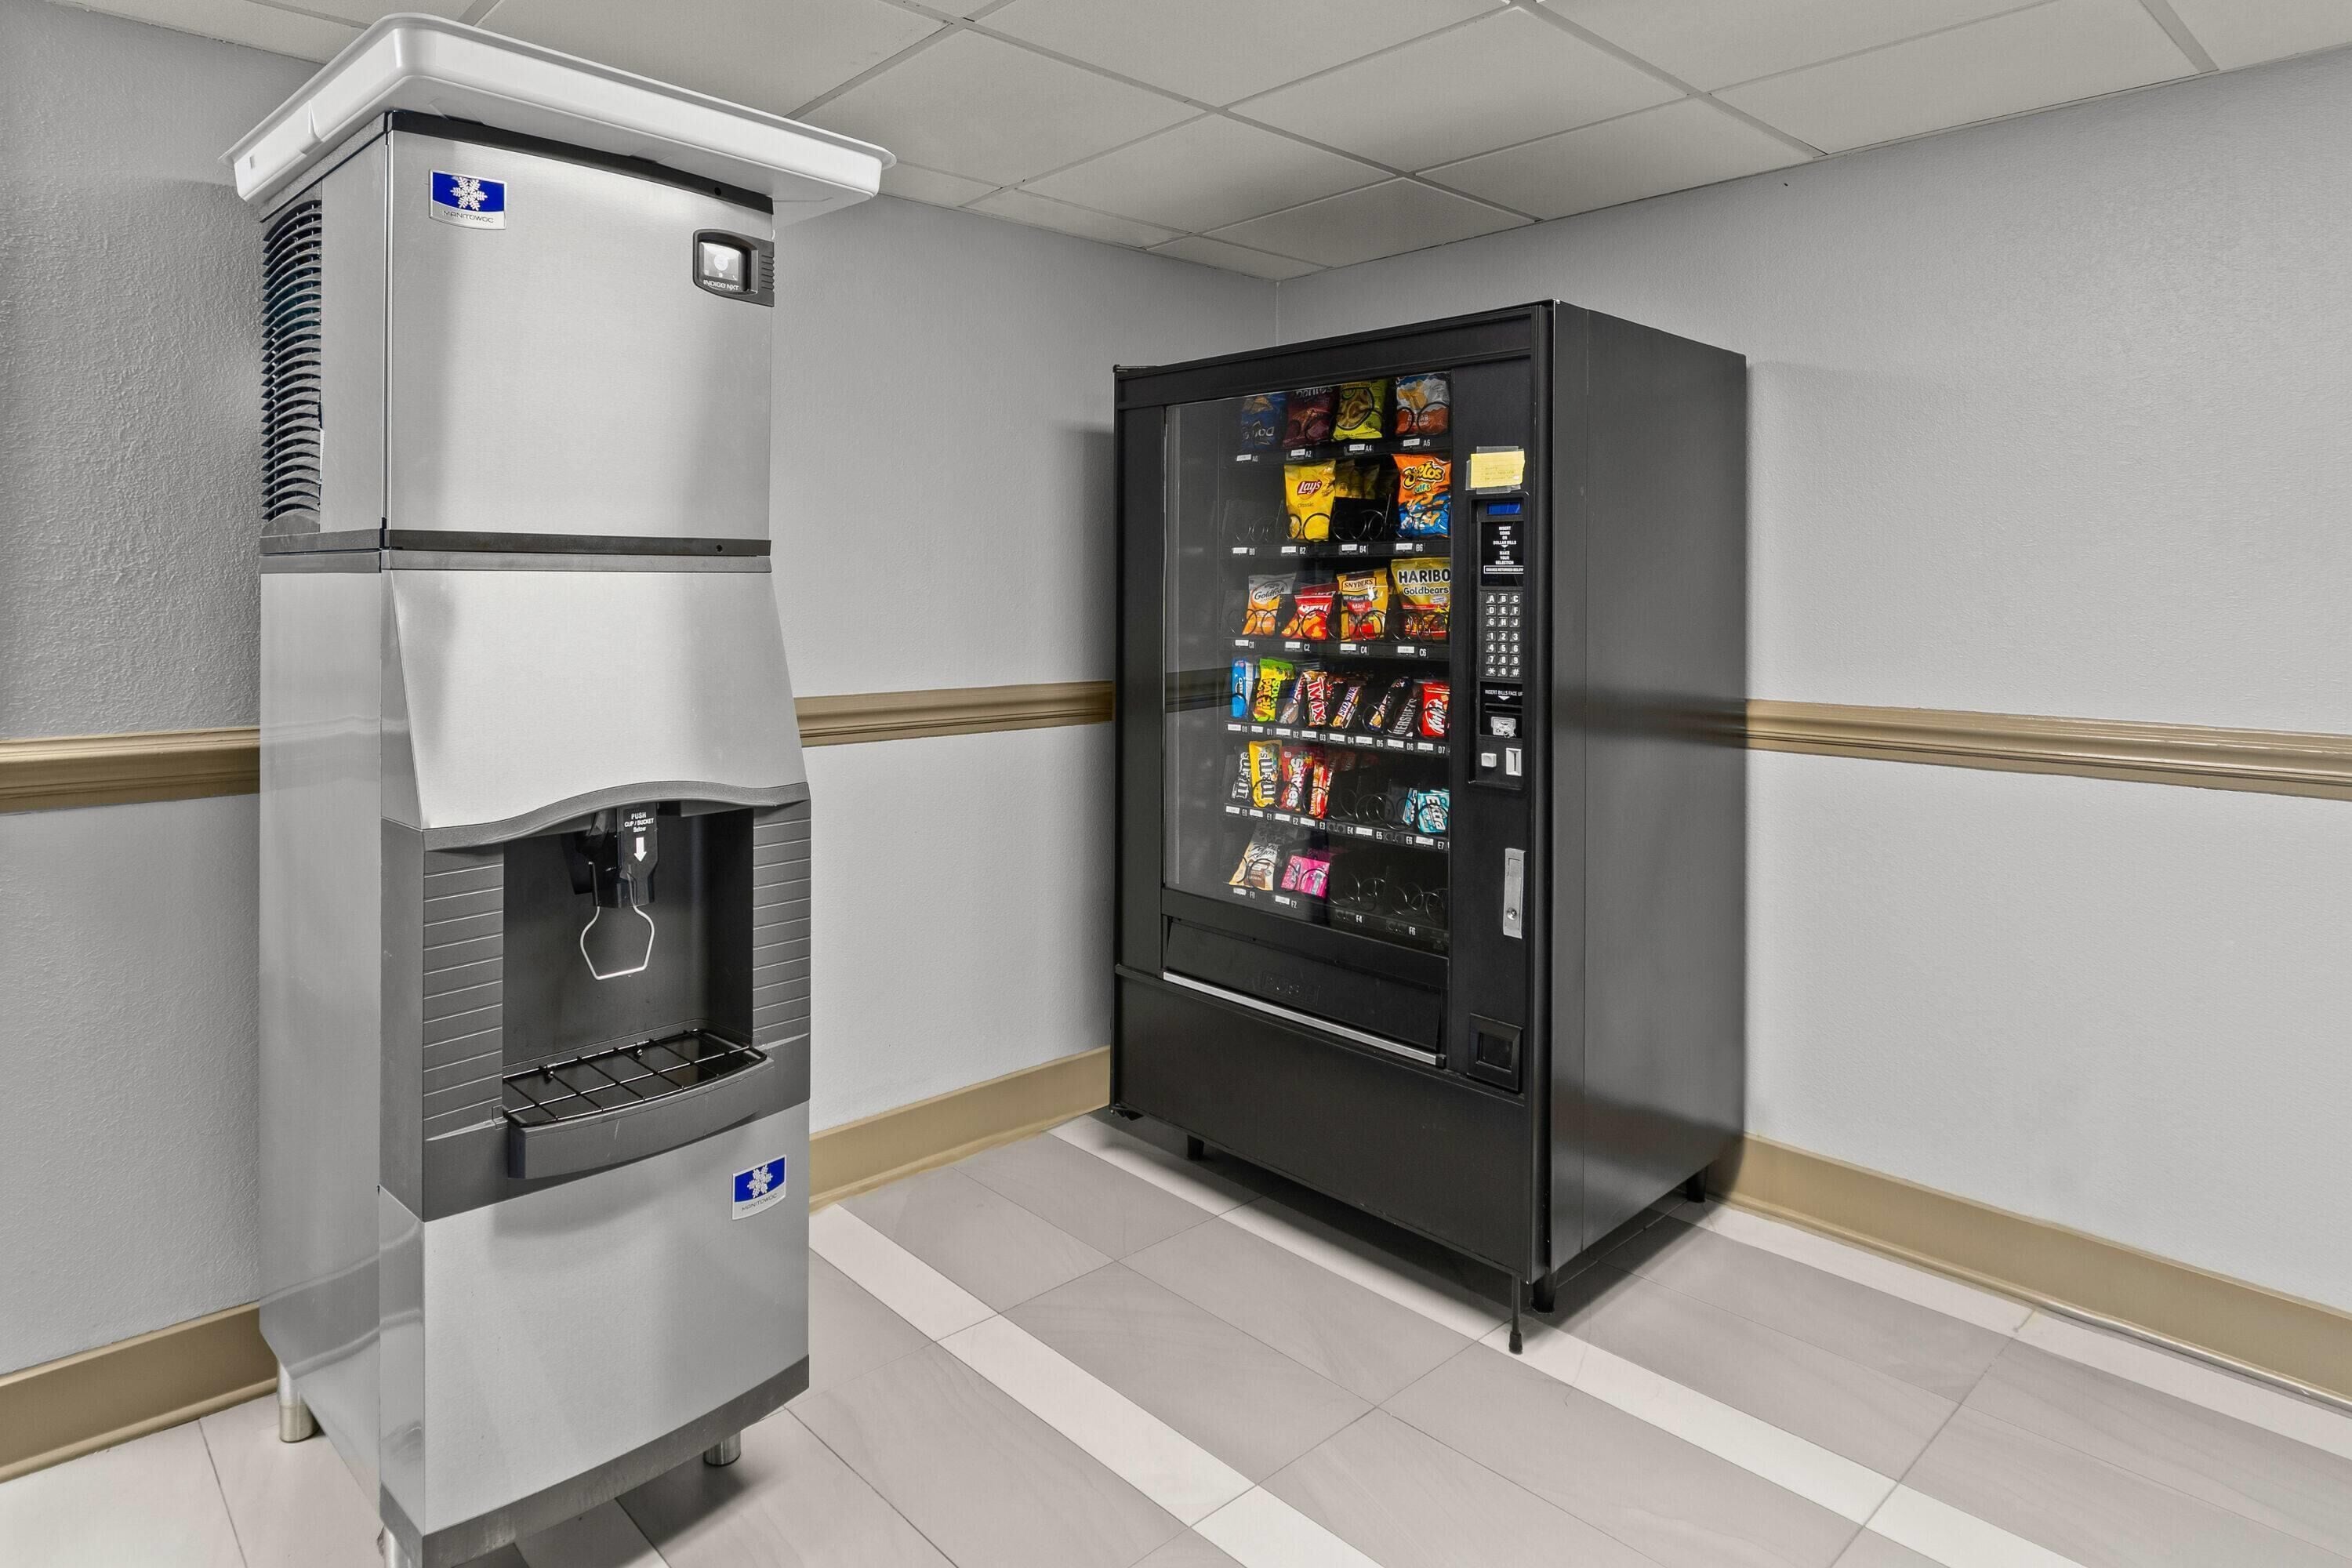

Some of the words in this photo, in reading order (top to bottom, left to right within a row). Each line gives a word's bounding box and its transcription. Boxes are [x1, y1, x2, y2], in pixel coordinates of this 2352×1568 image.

[443, 210, 494, 223] MANITOWOC
[703, 279, 726, 289] INDIGO
[1298, 481, 1321, 495] Lay's
[1416, 543, 1423, 552] B6
[1398, 568, 1451, 583] HARIBO
[1403, 586, 1450, 595] Goldbears
[1307, 677, 1327, 721] TWIX
[1406, 836, 1413, 844] E6
[1437, 841, 1444, 850] E7
